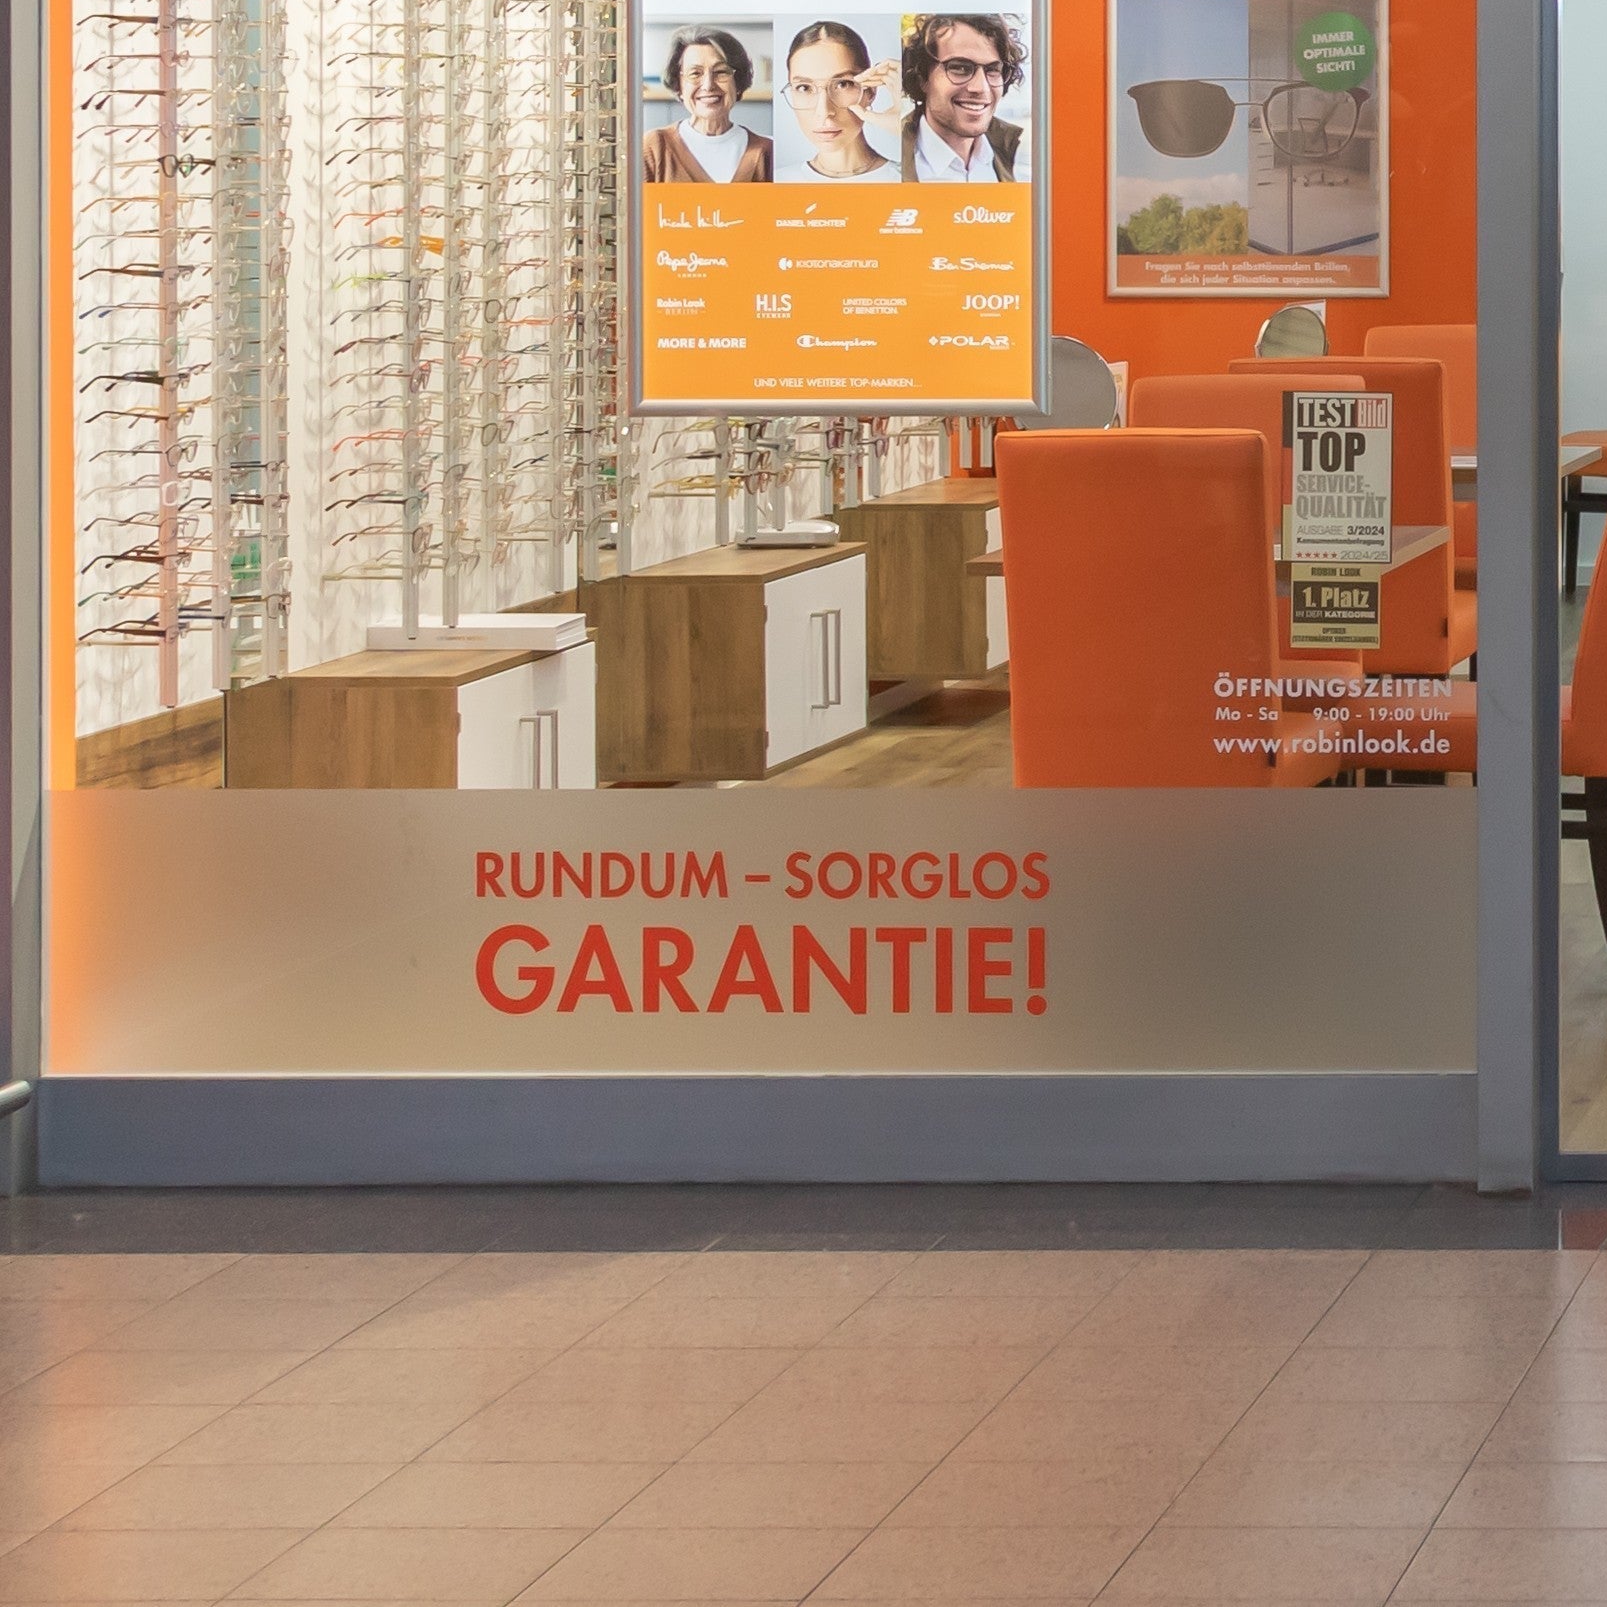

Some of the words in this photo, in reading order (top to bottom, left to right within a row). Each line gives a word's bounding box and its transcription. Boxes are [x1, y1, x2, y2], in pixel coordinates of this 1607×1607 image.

[1312, 31, 1355, 44] IMMER
[1303, 44, 1366, 61] OPTIMALE
[953, 206, 1015, 223] s.Oliver
[961, 295, 1020, 310] JOOP!
[657, 338, 695, 348] MORE
[709, 338, 747, 348] MORE
[797, 335, 877, 351] Champion
[754, 378, 777, 388] UND
[779, 378, 803, 388] VIELE
[807, 378, 847, 388] WEITERE
[1299, 398, 1355, 427] TEST
[1297, 431, 1366, 472] TOP
[1297, 474, 1370, 493] SERVICE-
[1296, 492, 1387, 519] QUALITÄT
[1297, 526, 1343, 535] AUSGABE
[1347, 526, 1384, 535] 3/2024
[1303, 587, 1316, 607] 1.
[1321, 587, 1369, 607] Platz
[1213, 672, 1452, 698] ÖFFNUNGSZEITEN
[1216, 707, 1241, 721] Mo
[1258, 707, 1278, 721] Sa
[1313, 707, 1350, 721] 9:00
[1369, 707, 1414, 721] 19:00
[1420, 707, 1452, 721] Uhr
[1213, 729, 1450, 754] www.robinlook.de
[475, 850, 729, 899] RUNDUM
[784, 850, 1051, 899] SORGLOS
[474, 924, 1048, 1016] GARANTIE!
